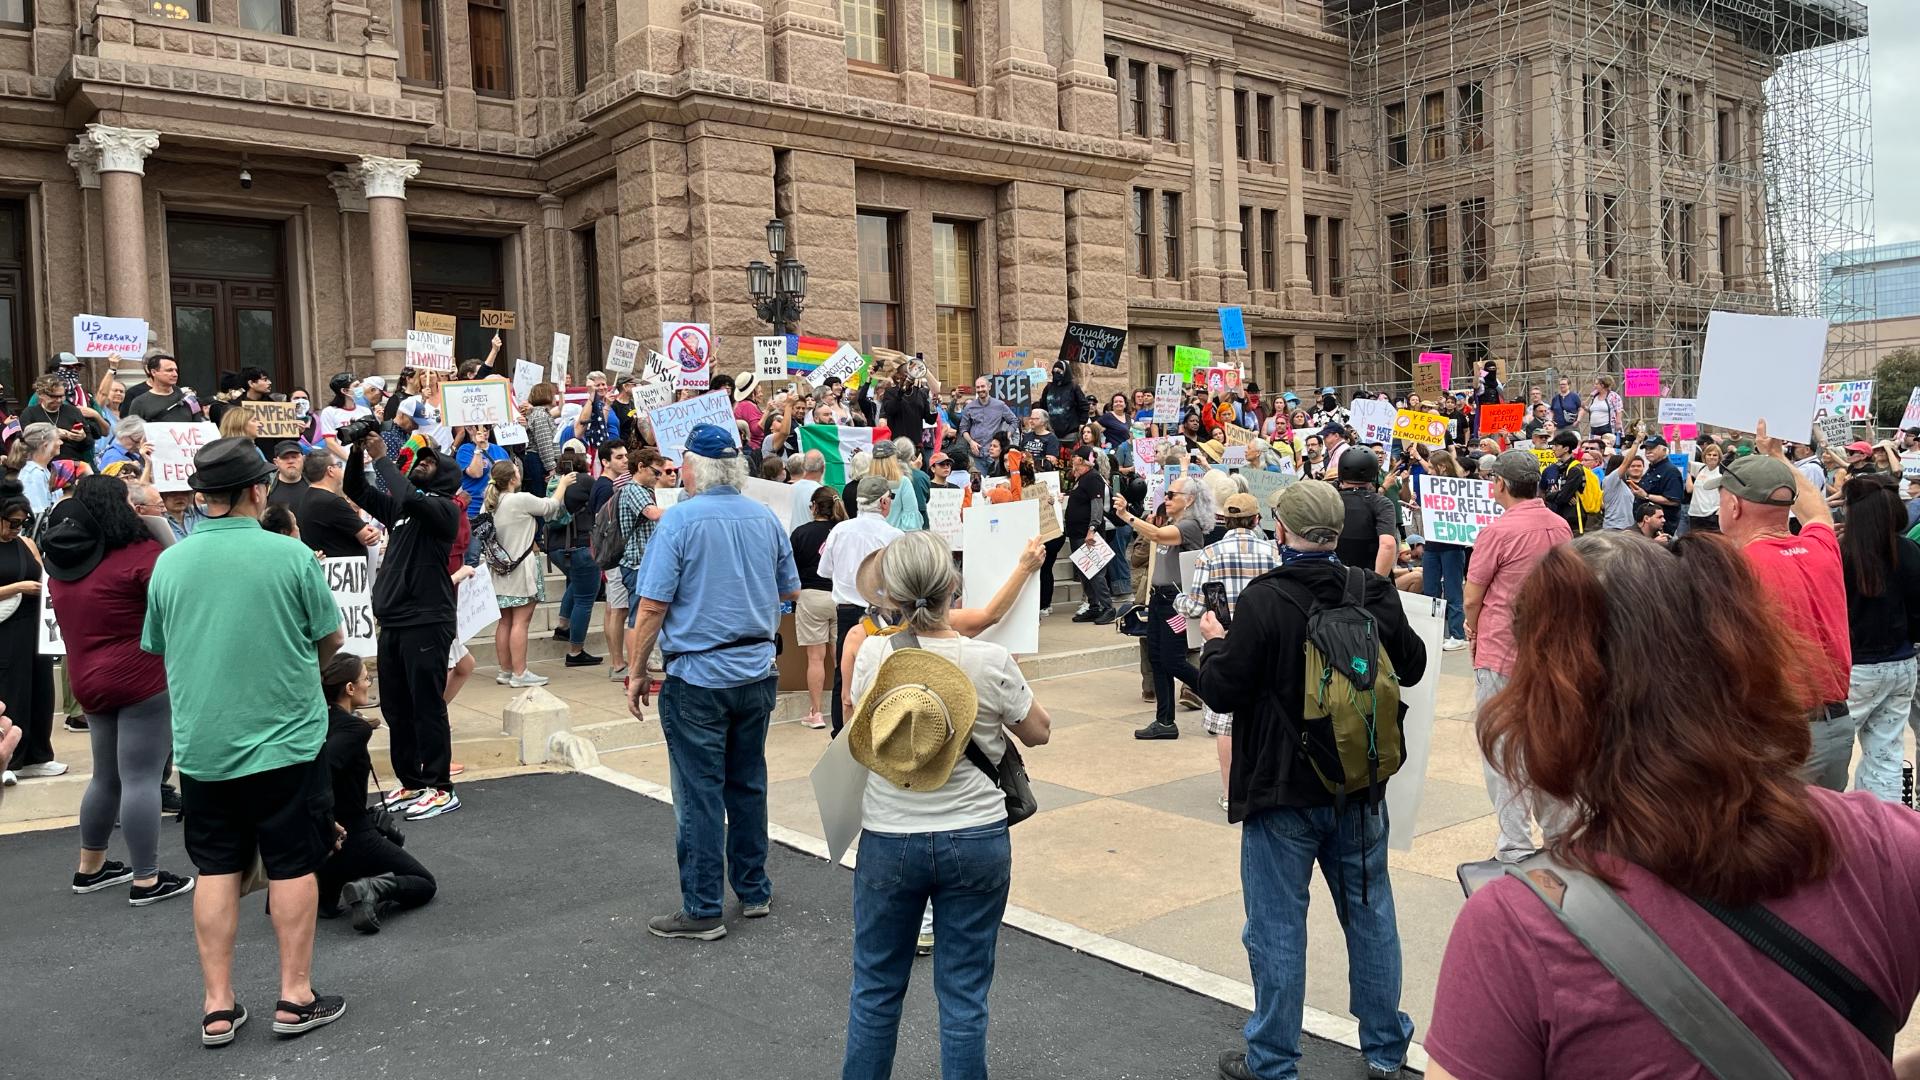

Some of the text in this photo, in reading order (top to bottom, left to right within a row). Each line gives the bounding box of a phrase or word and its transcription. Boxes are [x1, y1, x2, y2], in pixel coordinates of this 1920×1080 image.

[481, 312, 503, 326] NO!
[81, 320, 101, 332] US
[88, 332, 138, 343] TREASURY
[409, 331, 453, 346] STAND UP
[758, 339, 782, 347] TRUMP
[1069, 325, 1122, 349] equality
[86, 342, 142, 353] BREACHED!
[1082, 338, 1108, 349] HAS NO
[406, 351, 453, 370] HUMANITY
[764, 357, 778, 365] BAD
[763, 366, 781, 375] NEWS
[823, 355, 849, 379] PROJECT
[839, 356, 864, 379] 2025
[1417, 365, 1432, 373] IT
[683, 378, 709, 387] bozos
[1420, 373, 1434, 381] IS
[1817, 381, 1871, 394] EMPATHY
[1843, 390, 1869, 404] NOT
[1413, 413, 1433, 423] YES
[257, 422, 300, 437] RUMP
[661, 424, 686, 441] THE
[1376, 425, 1393, 435] HATE
[1413, 423, 1426, 431] TO
[1822, 423, 1850, 431] ELECTED
[1826, 429, 1846, 437] ELON
[169, 426, 205, 447] WE
[1376, 434, 1392, 443] FEAR
[1392, 430, 1443, 445] DEMOCRACY
[1430, 477, 1483, 499] PEOPLE
[1423, 493, 1503, 515] NEED RELIG
[1434, 510, 1468, 524] THEY
[342, 604, 374, 639] VES
